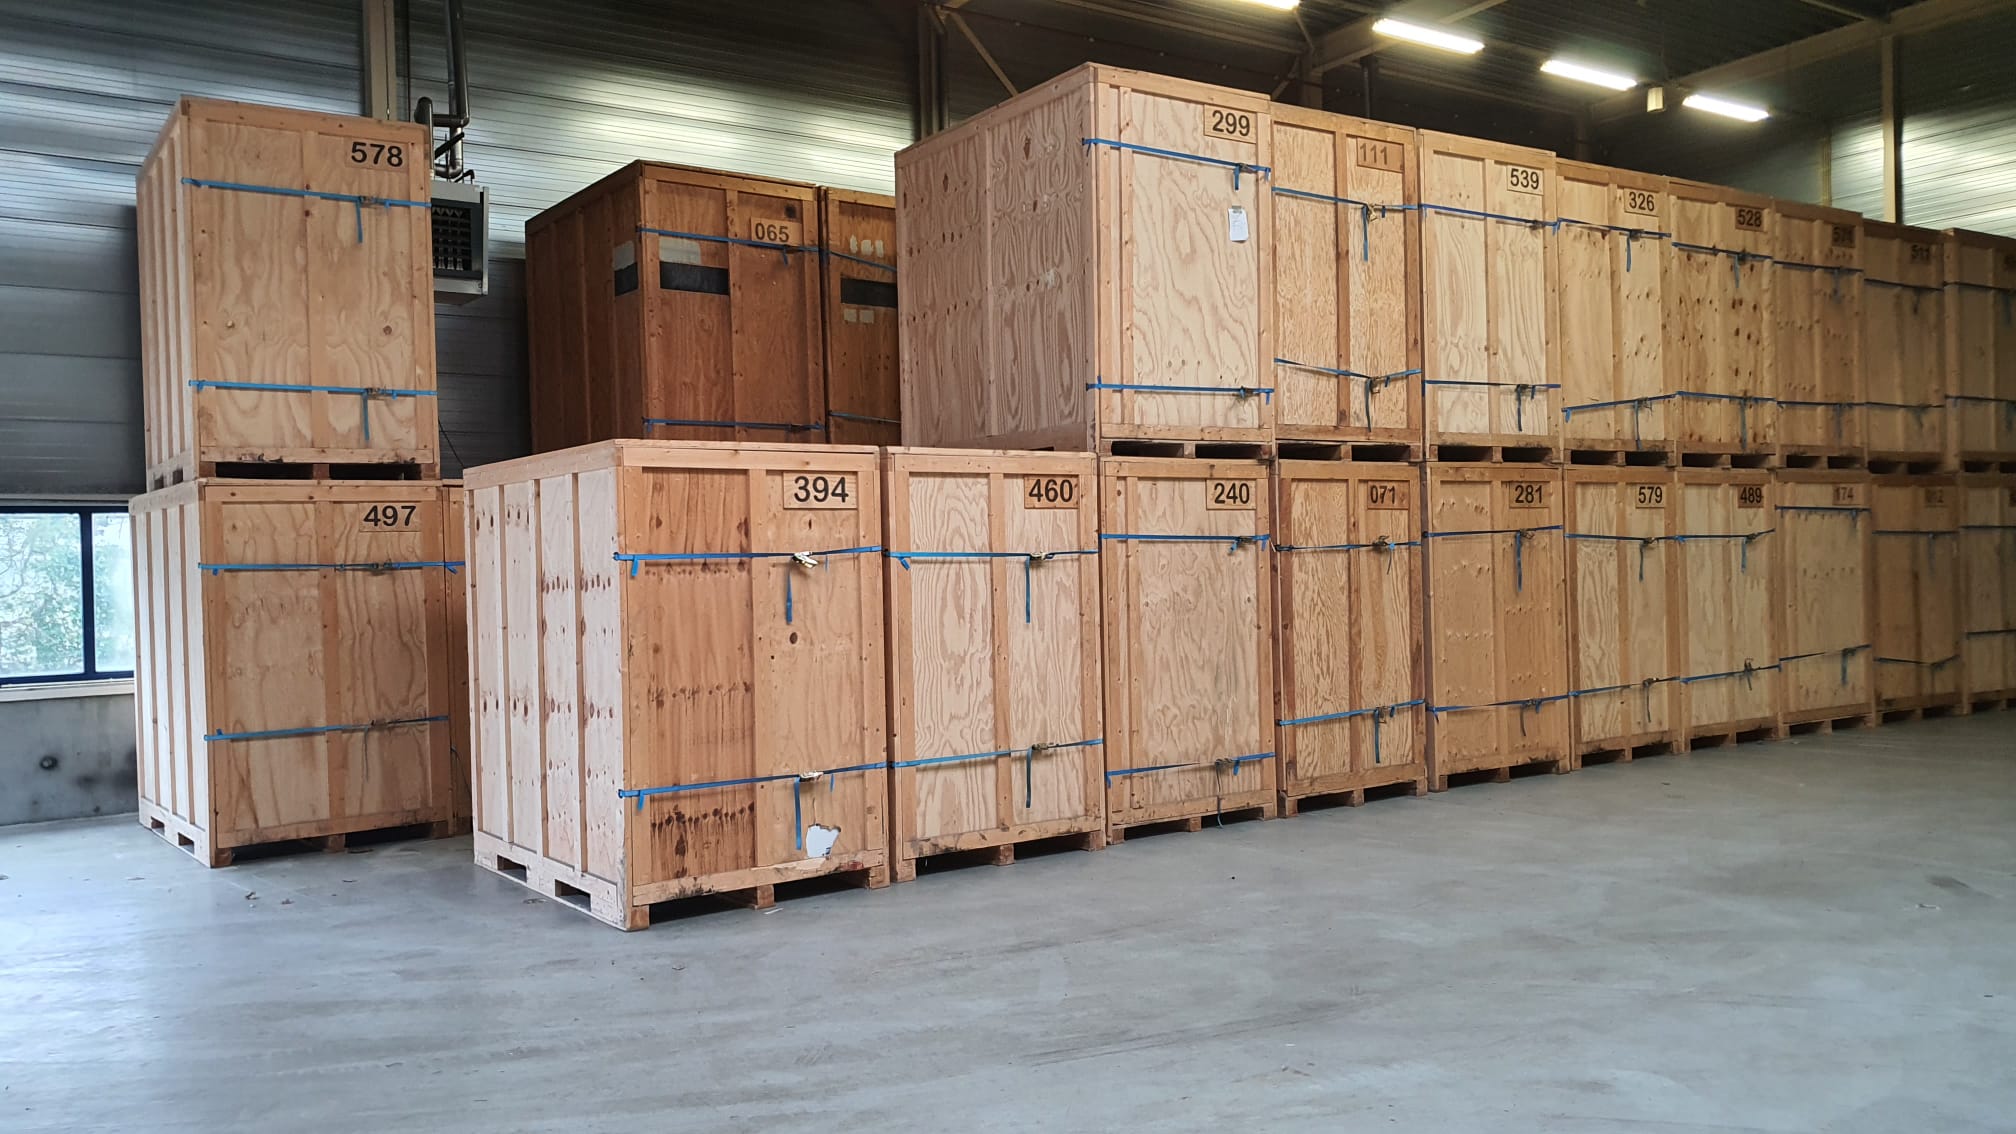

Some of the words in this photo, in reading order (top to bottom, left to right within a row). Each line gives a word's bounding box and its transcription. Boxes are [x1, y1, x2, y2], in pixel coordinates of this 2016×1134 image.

[1212, 109, 1250, 136] 299
[350, 141, 404, 168] 578
[1359, 143, 1388, 164] 111
[1510, 168, 1540, 190] 539
[1629, 191, 1655, 212] 326
[1736, 209, 1763, 228] 528
[755, 222, 789, 242] 065
[793, 476, 849, 503] 394
[1029, 479, 1074, 503] 460
[1214, 482, 1250, 505] 240
[1370, 485, 1397, 505] 071
[1515, 484, 1543, 504] 281
[1638, 486, 1663, 504] 579
[1740, 487, 1763, 504] 489
[363, 505, 418, 529] 497
